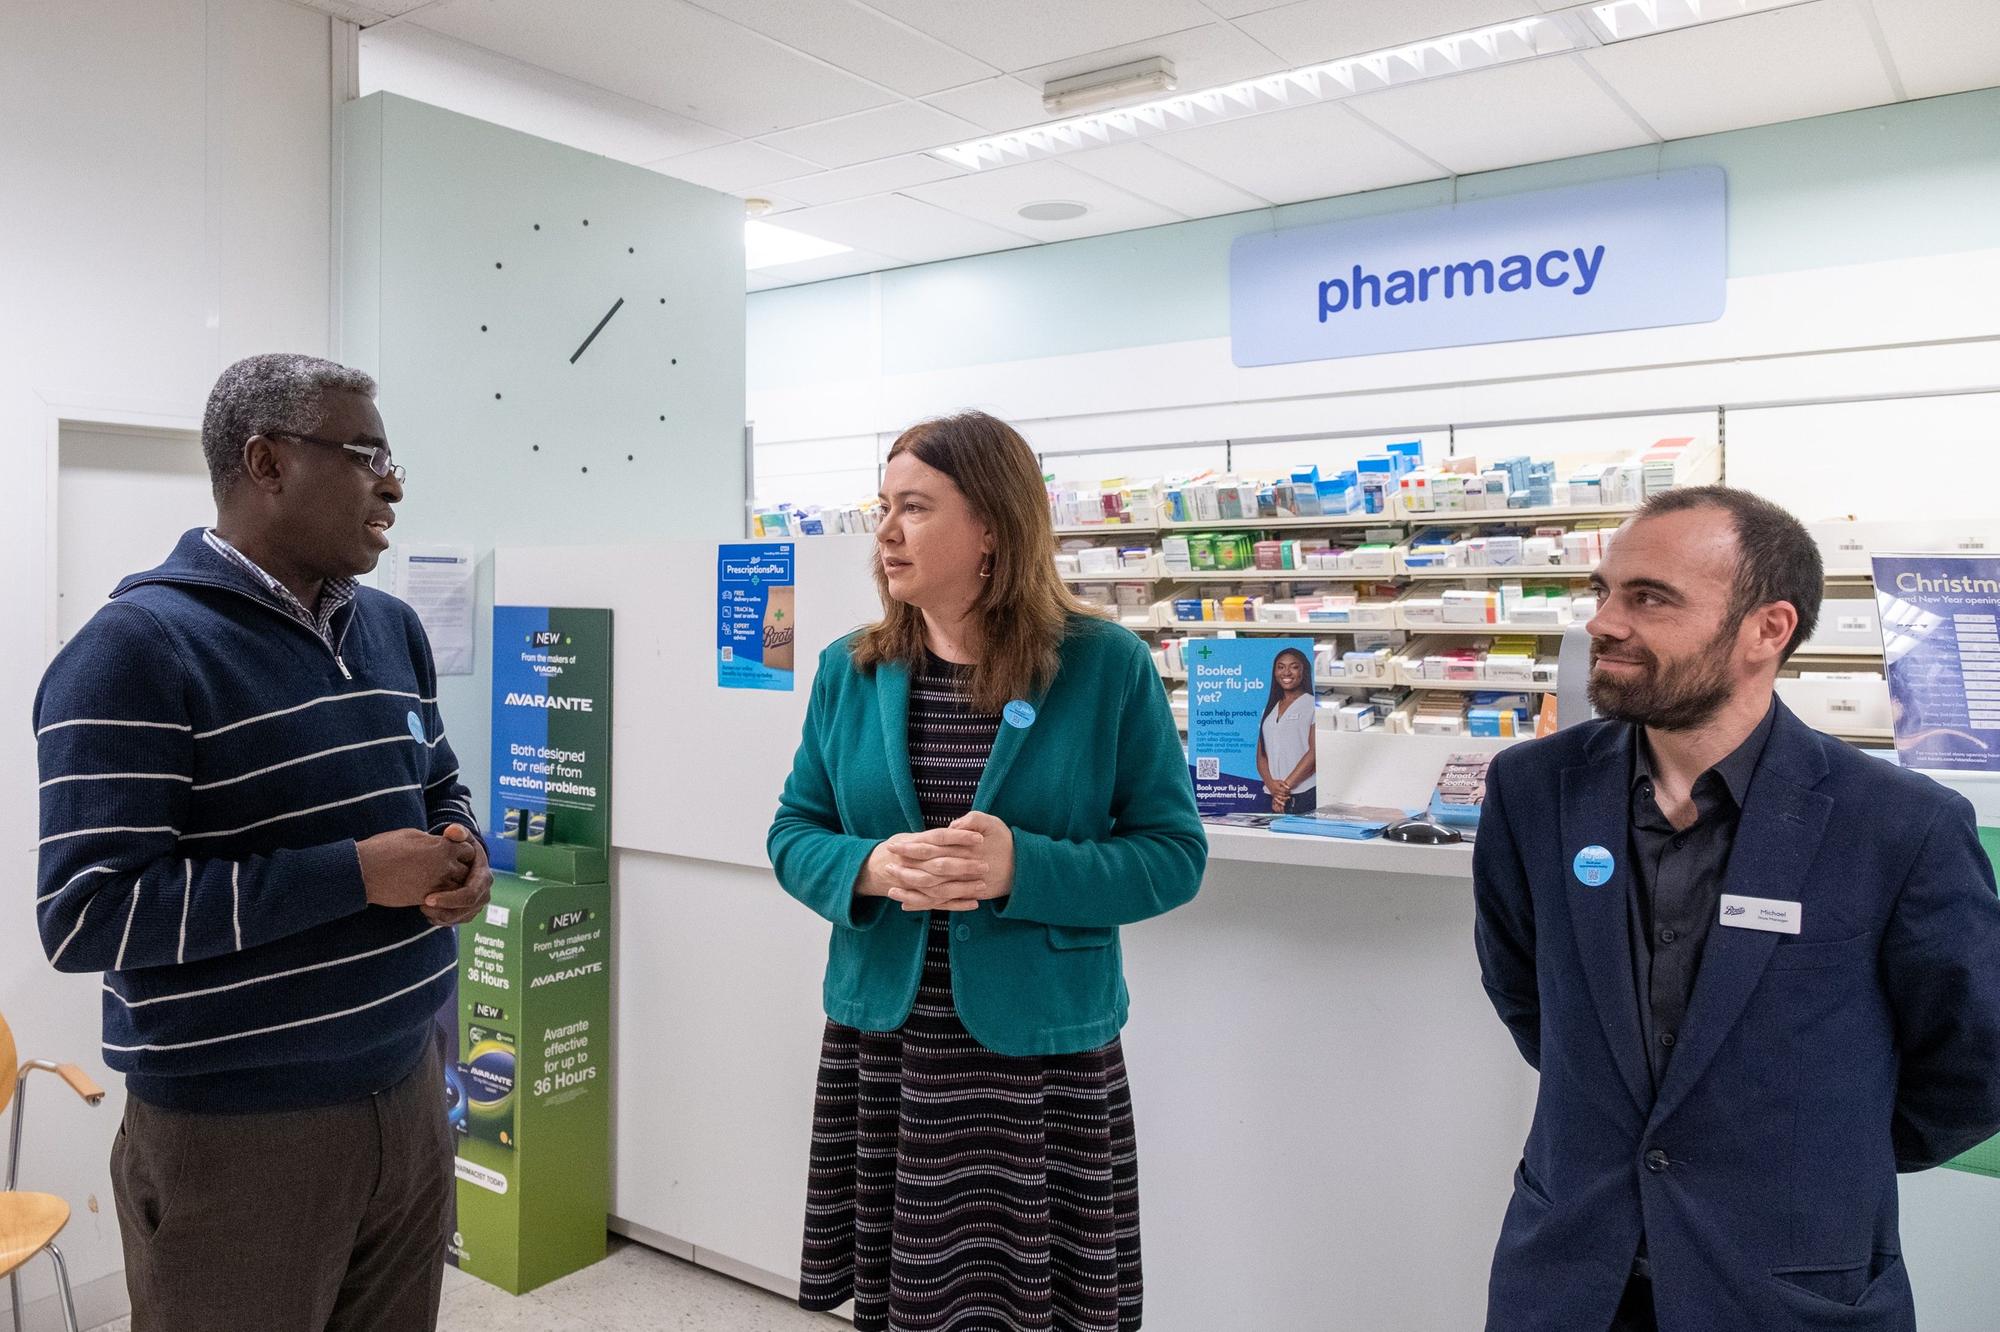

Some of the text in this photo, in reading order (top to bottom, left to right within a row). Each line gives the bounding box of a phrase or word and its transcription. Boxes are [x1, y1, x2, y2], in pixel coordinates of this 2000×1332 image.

[1318, 245, 1604, 323] pharmacy
[727, 565, 784, 576] PrescriptionsPlus
[1896, 573, 2000, 593] Christm
[1964, 597, 2000, 606] opening
[536, 632, 560, 645] NEW
[521, 653, 576, 665] From the makers of
[533, 665, 563, 674] VIAGRA
[1196, 664, 1242, 676] Booked
[1196, 678, 1264, 692] your flu jab
[504, 692, 593, 712] AVARANTE
[1196, 692, 1222, 705] yet?
[1196, 718, 1223, 727] against
[1215, 710, 1230, 719] help
[1232, 710, 1257, 719] protect
[511, 744, 585, 763] Both designed
[512, 759, 582, 779] for relief from
[500, 775, 596, 797] erection problems
[1238, 792, 1256, 800] today
[553, 911, 583, 929] NEW
[474, 932, 505, 949] Avarante
[534, 929, 601, 952] From the makers of
[474, 946, 504, 961] effective
[548, 945, 585, 960] VIAGRA
[474, 958, 504, 974] for up to
[467, 968, 510, 990] 36 Hours
[530, 962, 602, 989] AVARANTE
[477, 1004, 499, 1018] NEW
[544, 1020, 589, 1042] Avarante
[544, 1035, 588, 1058] effective
[544, 1052, 588, 1074] for up to
[470, 1067, 513, 1087] AVARANTE
[533, 1078, 551, 1097] 36
[555, 1066, 596, 1090] Hours
[455, 1164, 504, 1187] HARMACIST TODAY
